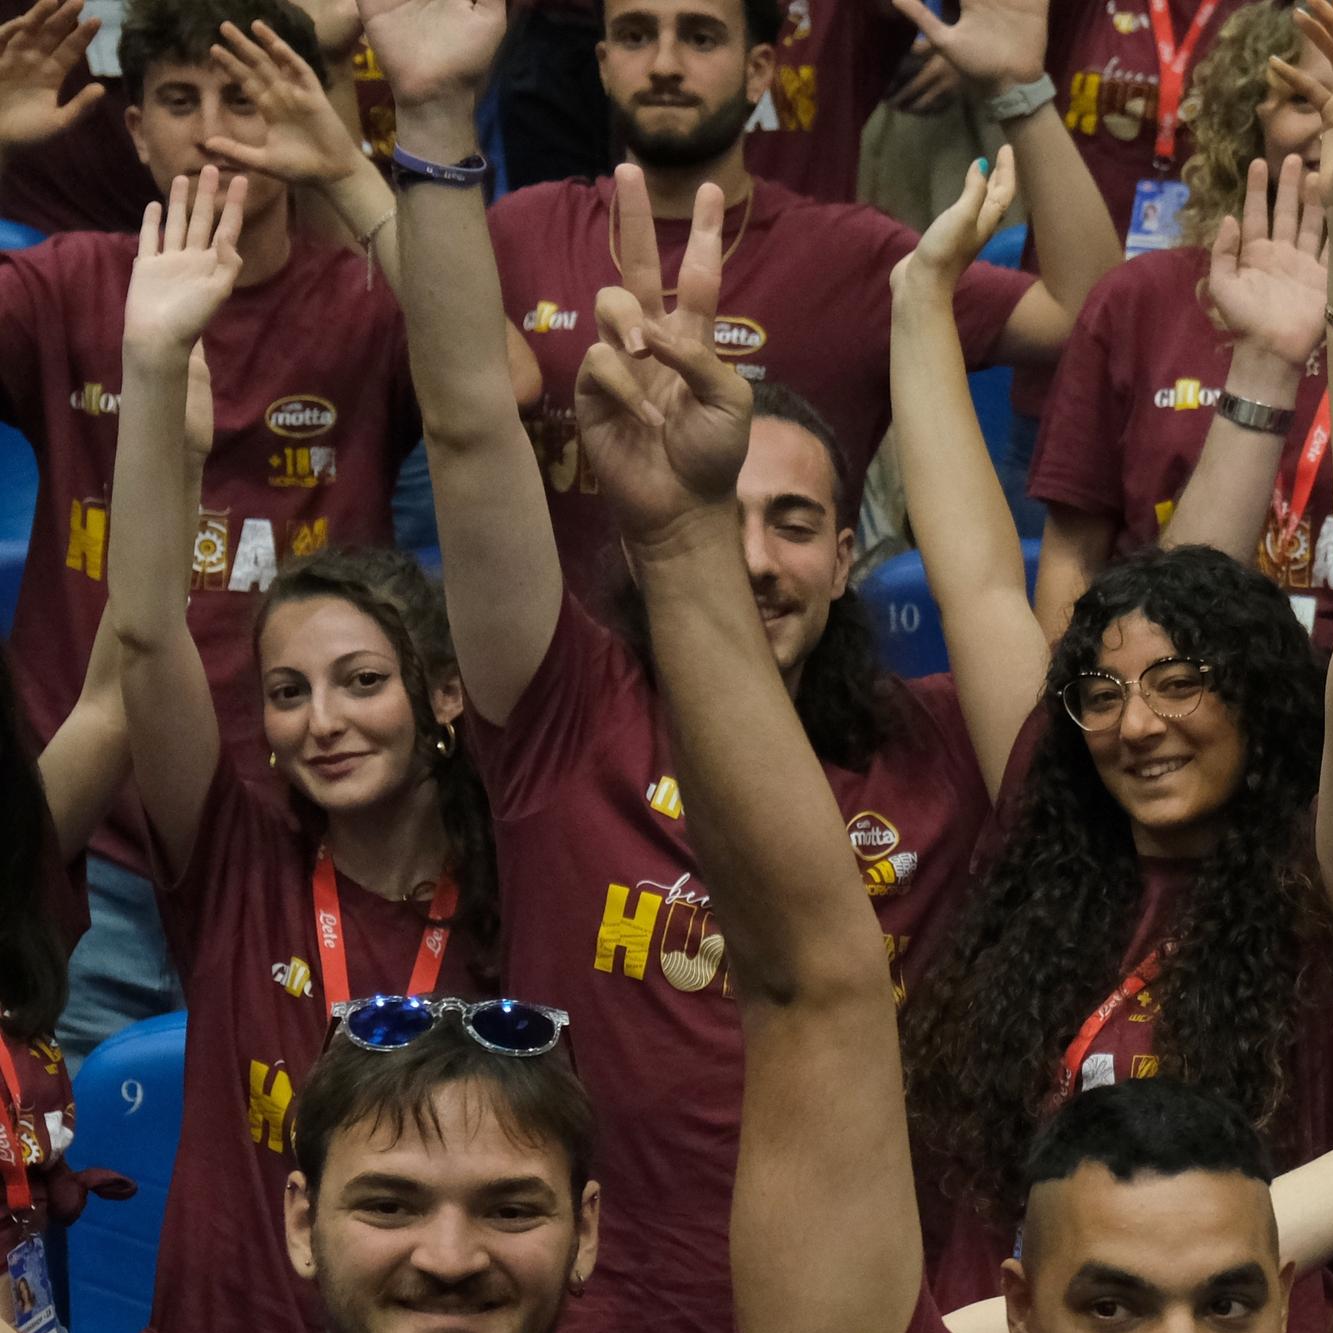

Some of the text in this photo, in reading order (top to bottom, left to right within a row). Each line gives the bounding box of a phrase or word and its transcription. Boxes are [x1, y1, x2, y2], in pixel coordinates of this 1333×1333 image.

[271, 406, 332, 427] motta
[320, 908, 338, 949] Lete
[120, 1078, 144, 1116] 9
